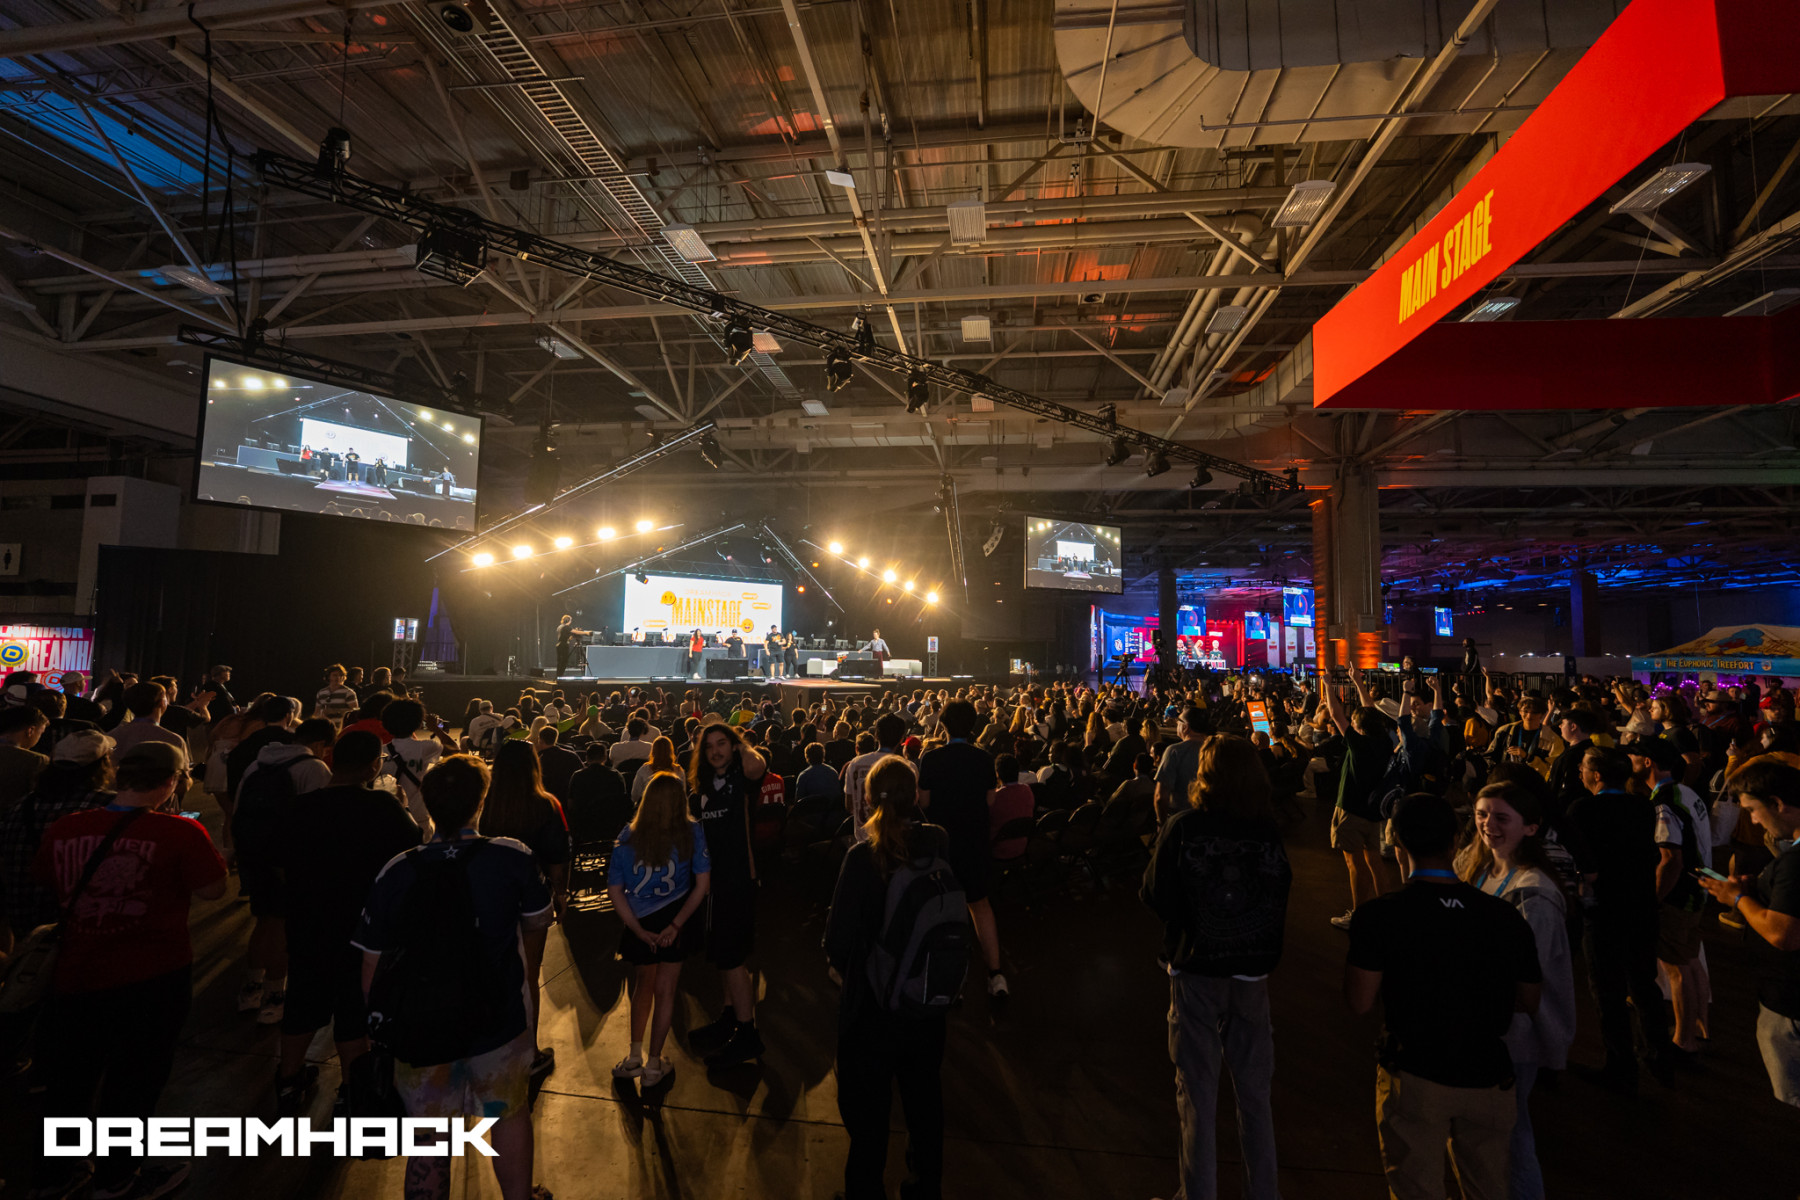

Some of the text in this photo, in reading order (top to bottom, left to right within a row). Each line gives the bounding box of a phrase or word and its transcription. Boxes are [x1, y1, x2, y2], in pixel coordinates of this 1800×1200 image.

[1399, 189, 1494, 325] MAIN STAGE
[671, 597, 743, 629] MAINSTAGE
[1666, 658, 1677, 668] THE
[1717, 659, 1754, 670] TREEFORT
[633, 859, 676, 898] 23
